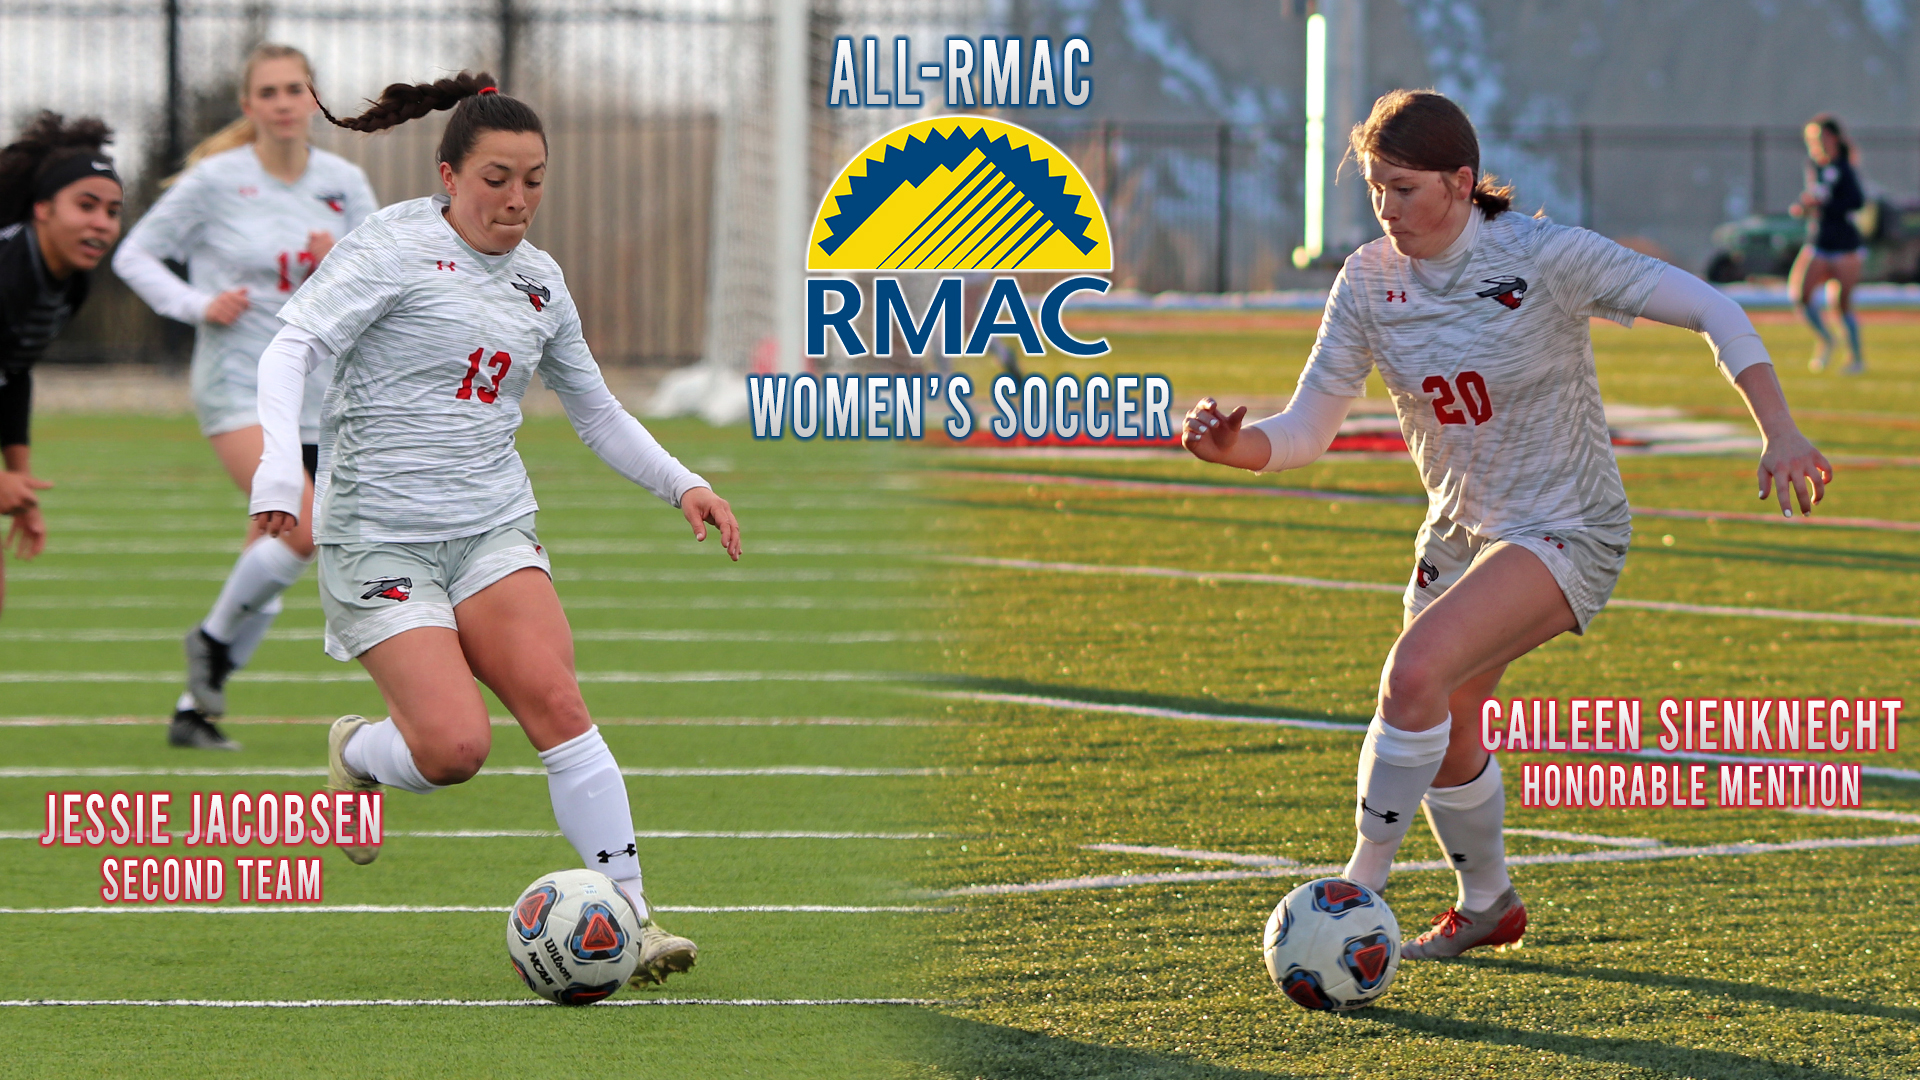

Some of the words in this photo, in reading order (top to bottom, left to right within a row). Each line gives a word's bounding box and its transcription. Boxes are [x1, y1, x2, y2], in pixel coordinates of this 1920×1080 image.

[455, 346, 512, 405] 13
[1421, 371, 1493, 426] 20
[527, 951, 555, 986] NCAA
[544, 937, 572, 982] Wilson
